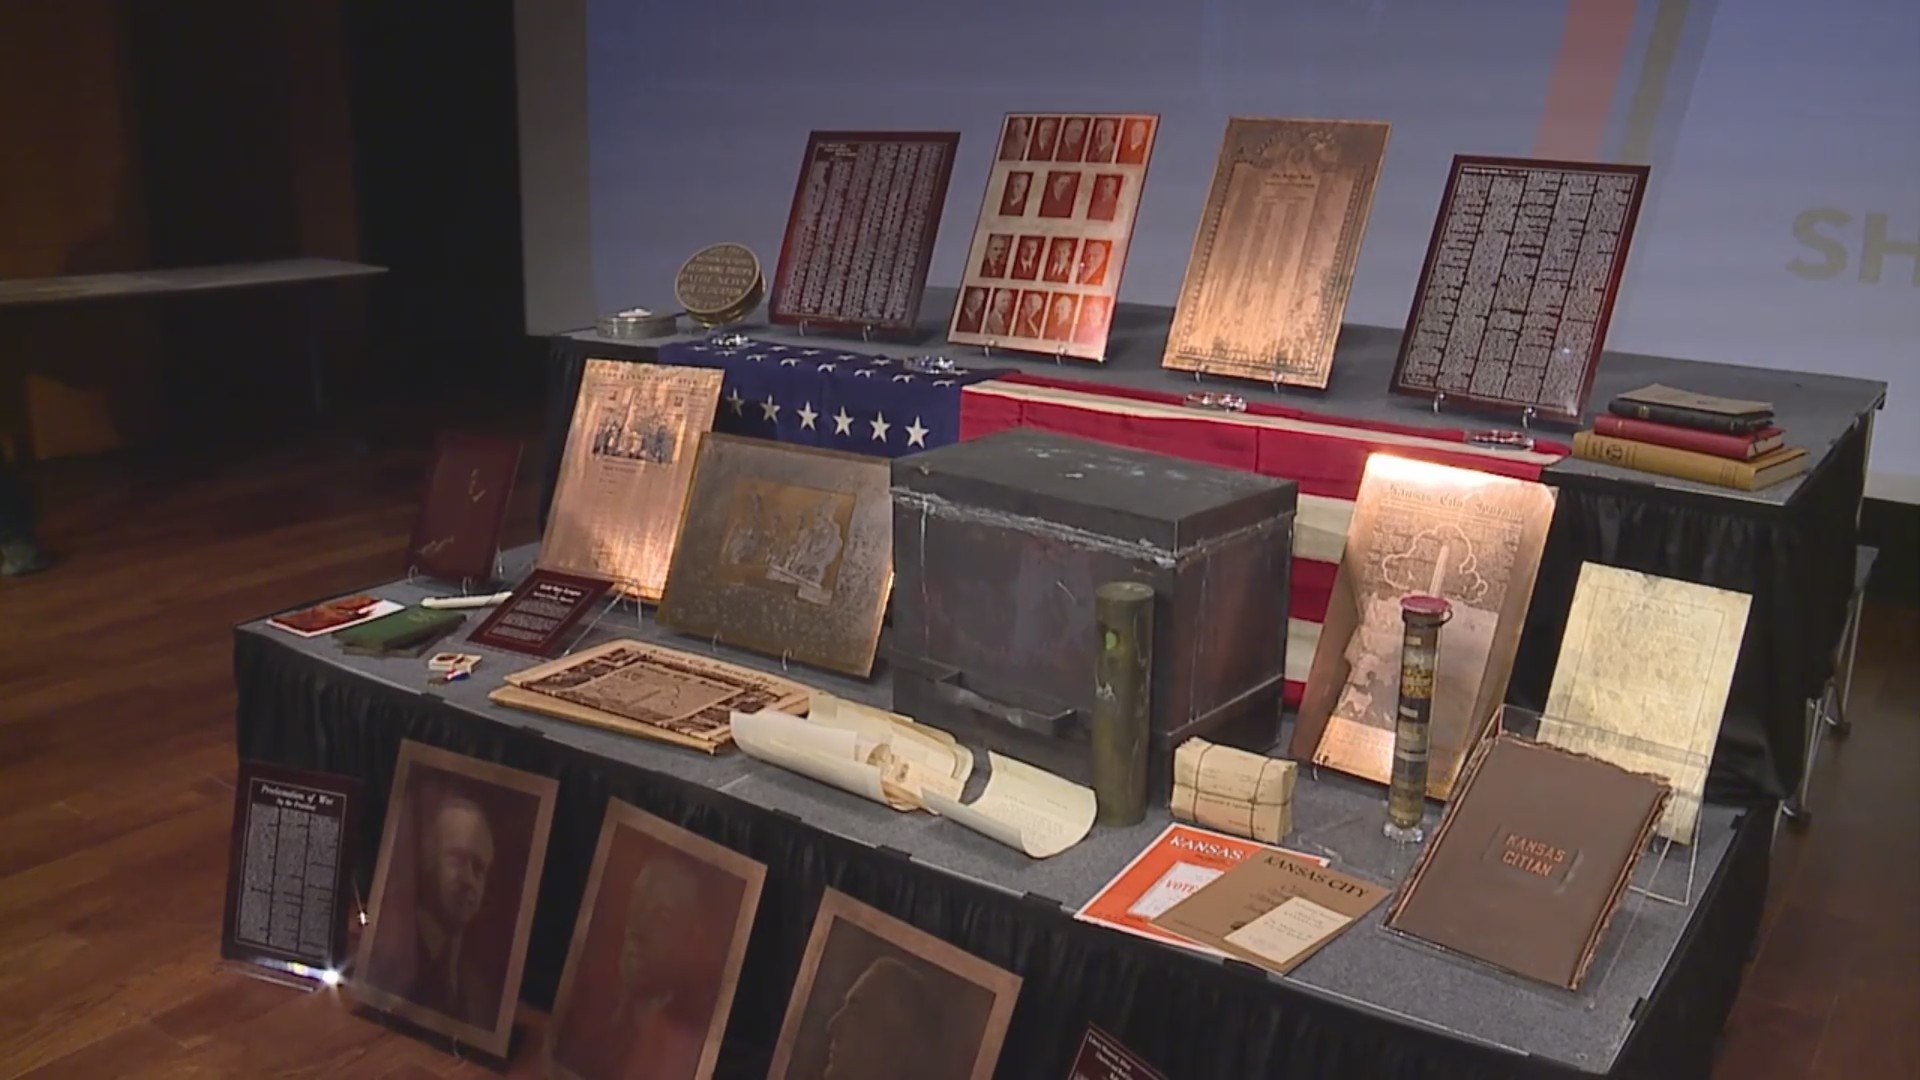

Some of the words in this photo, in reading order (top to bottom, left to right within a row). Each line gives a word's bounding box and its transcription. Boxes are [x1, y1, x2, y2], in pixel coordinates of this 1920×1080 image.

[1169, 835, 1245, 860] KANSAS
[1506, 833, 1566, 863] KANSAS
[1264, 855, 1327, 883] KANSAS
[1328, 879, 1369, 899] CITY
[1502, 849, 1553, 878] CITIAN
